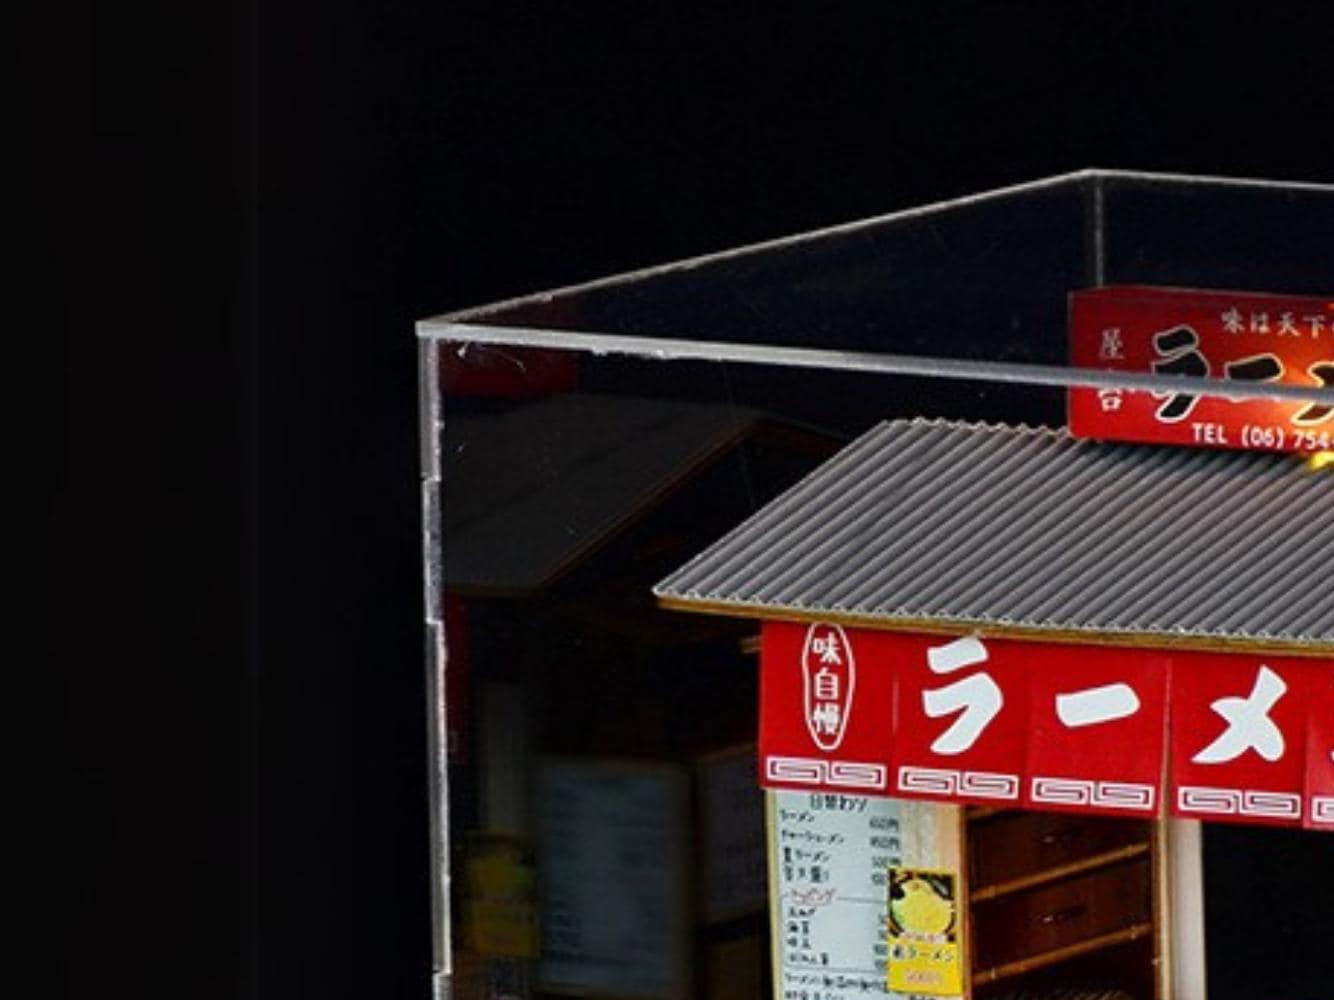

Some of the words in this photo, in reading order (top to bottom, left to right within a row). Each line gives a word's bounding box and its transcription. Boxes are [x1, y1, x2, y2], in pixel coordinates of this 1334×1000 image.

[1191, 422, 1228, 446] TEL
[1240, 424, 1284, 450] (06)
[811, 636, 840, 736] 味自慢
